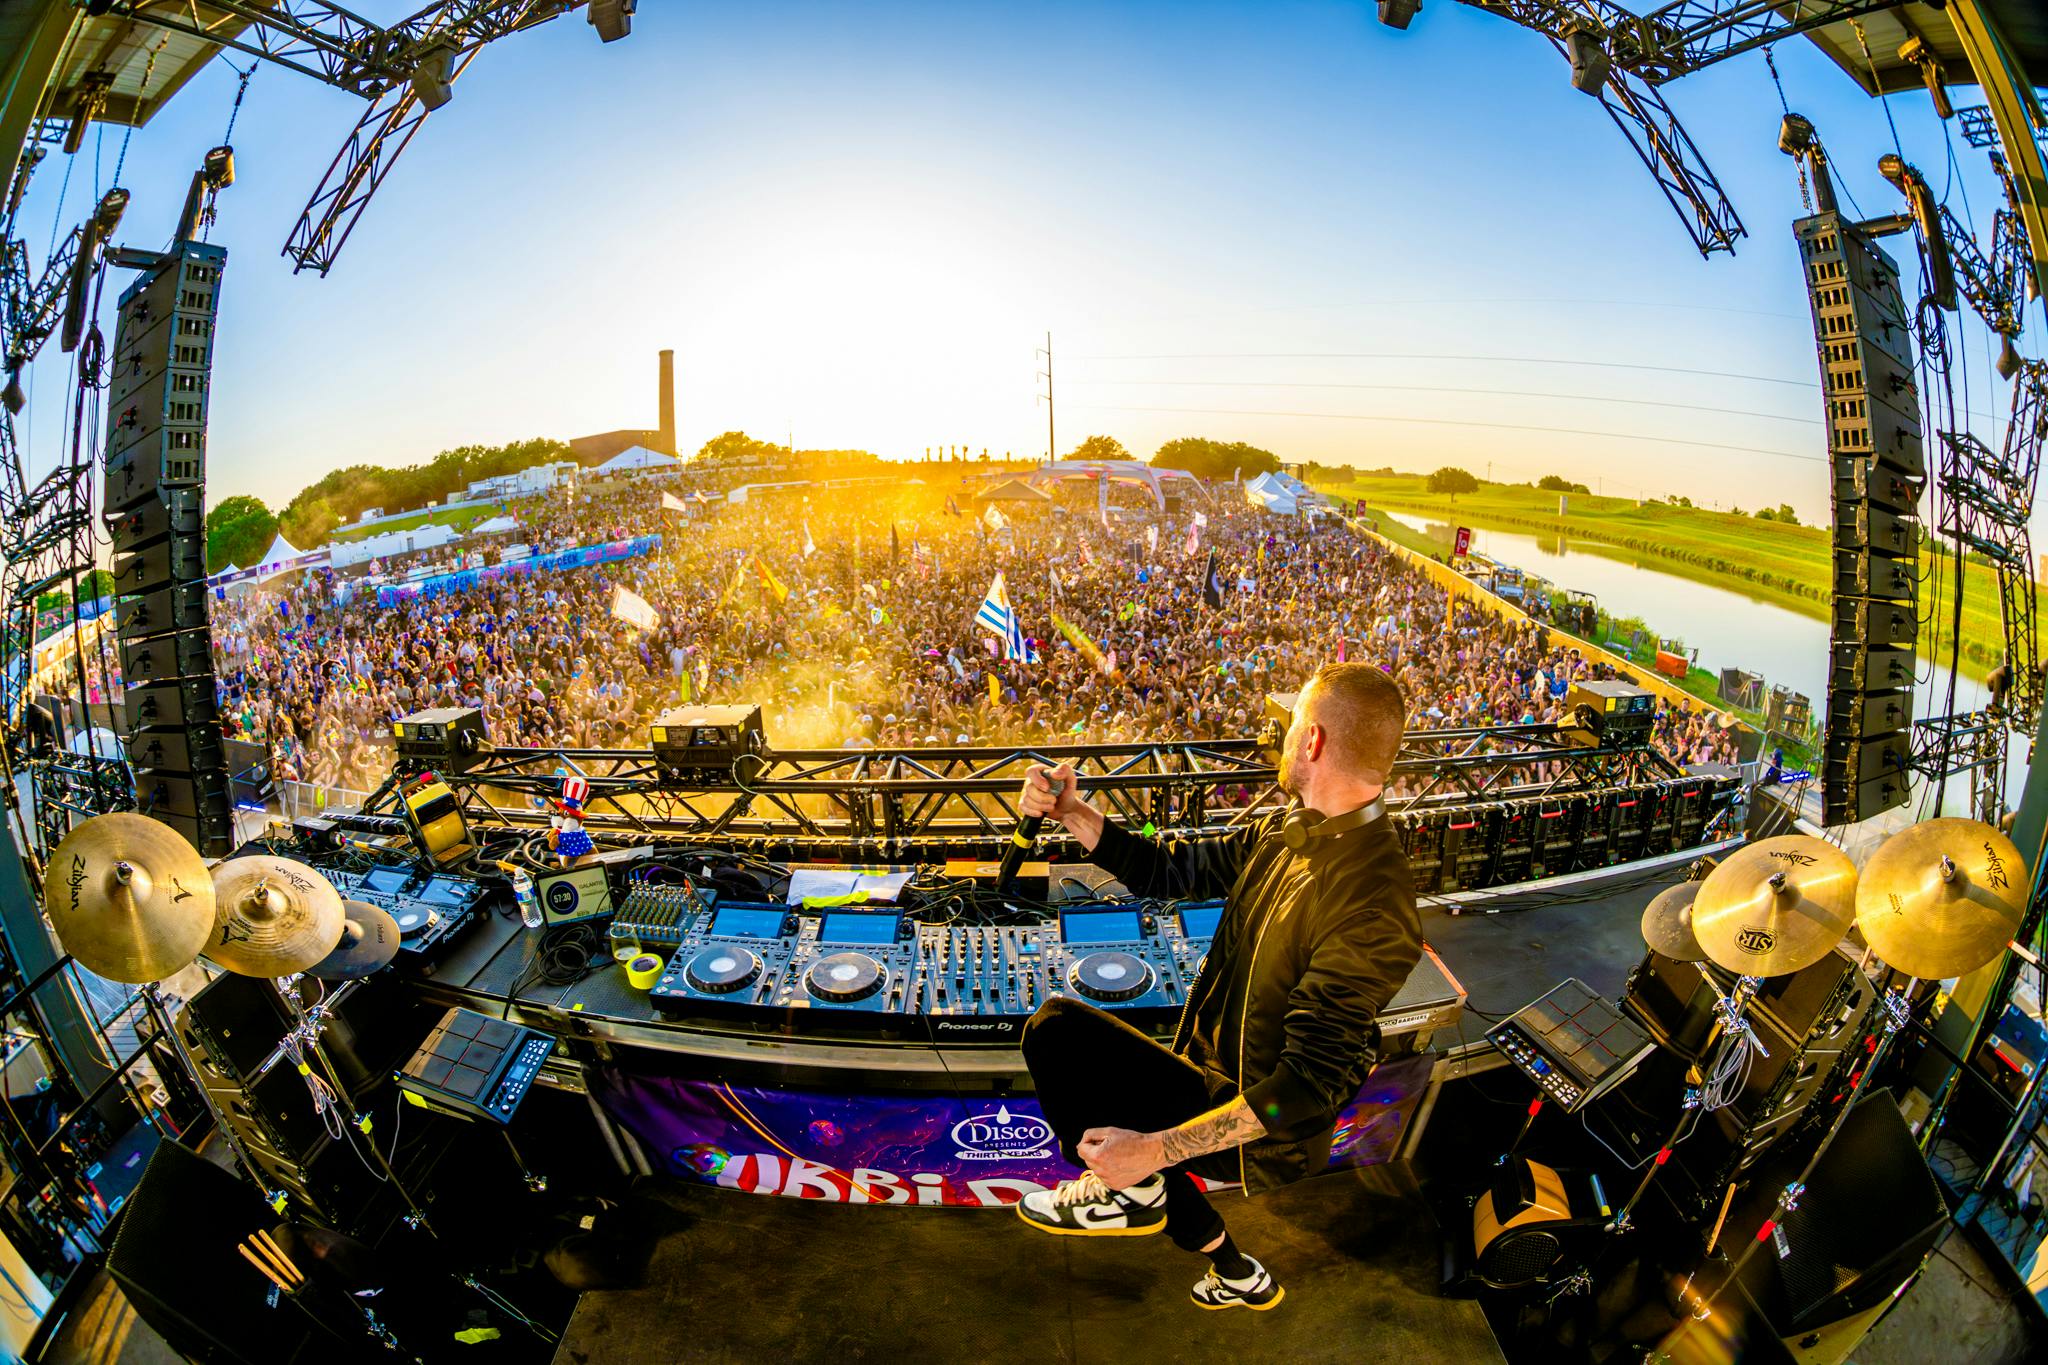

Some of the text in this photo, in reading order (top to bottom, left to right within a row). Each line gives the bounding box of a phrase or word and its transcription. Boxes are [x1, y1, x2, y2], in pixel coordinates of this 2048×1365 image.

[1769, 850, 1819, 867] Zildjian
[1983, 841, 2010, 889] Zildjian
[66, 853, 89, 912] Zildjian
[274, 865, 316, 893] Zildjian
[553, 892, 572, 904] 57:30
[442, 918, 467, 943] Pioneer
[938, 1022, 995, 1030] Pioneer
